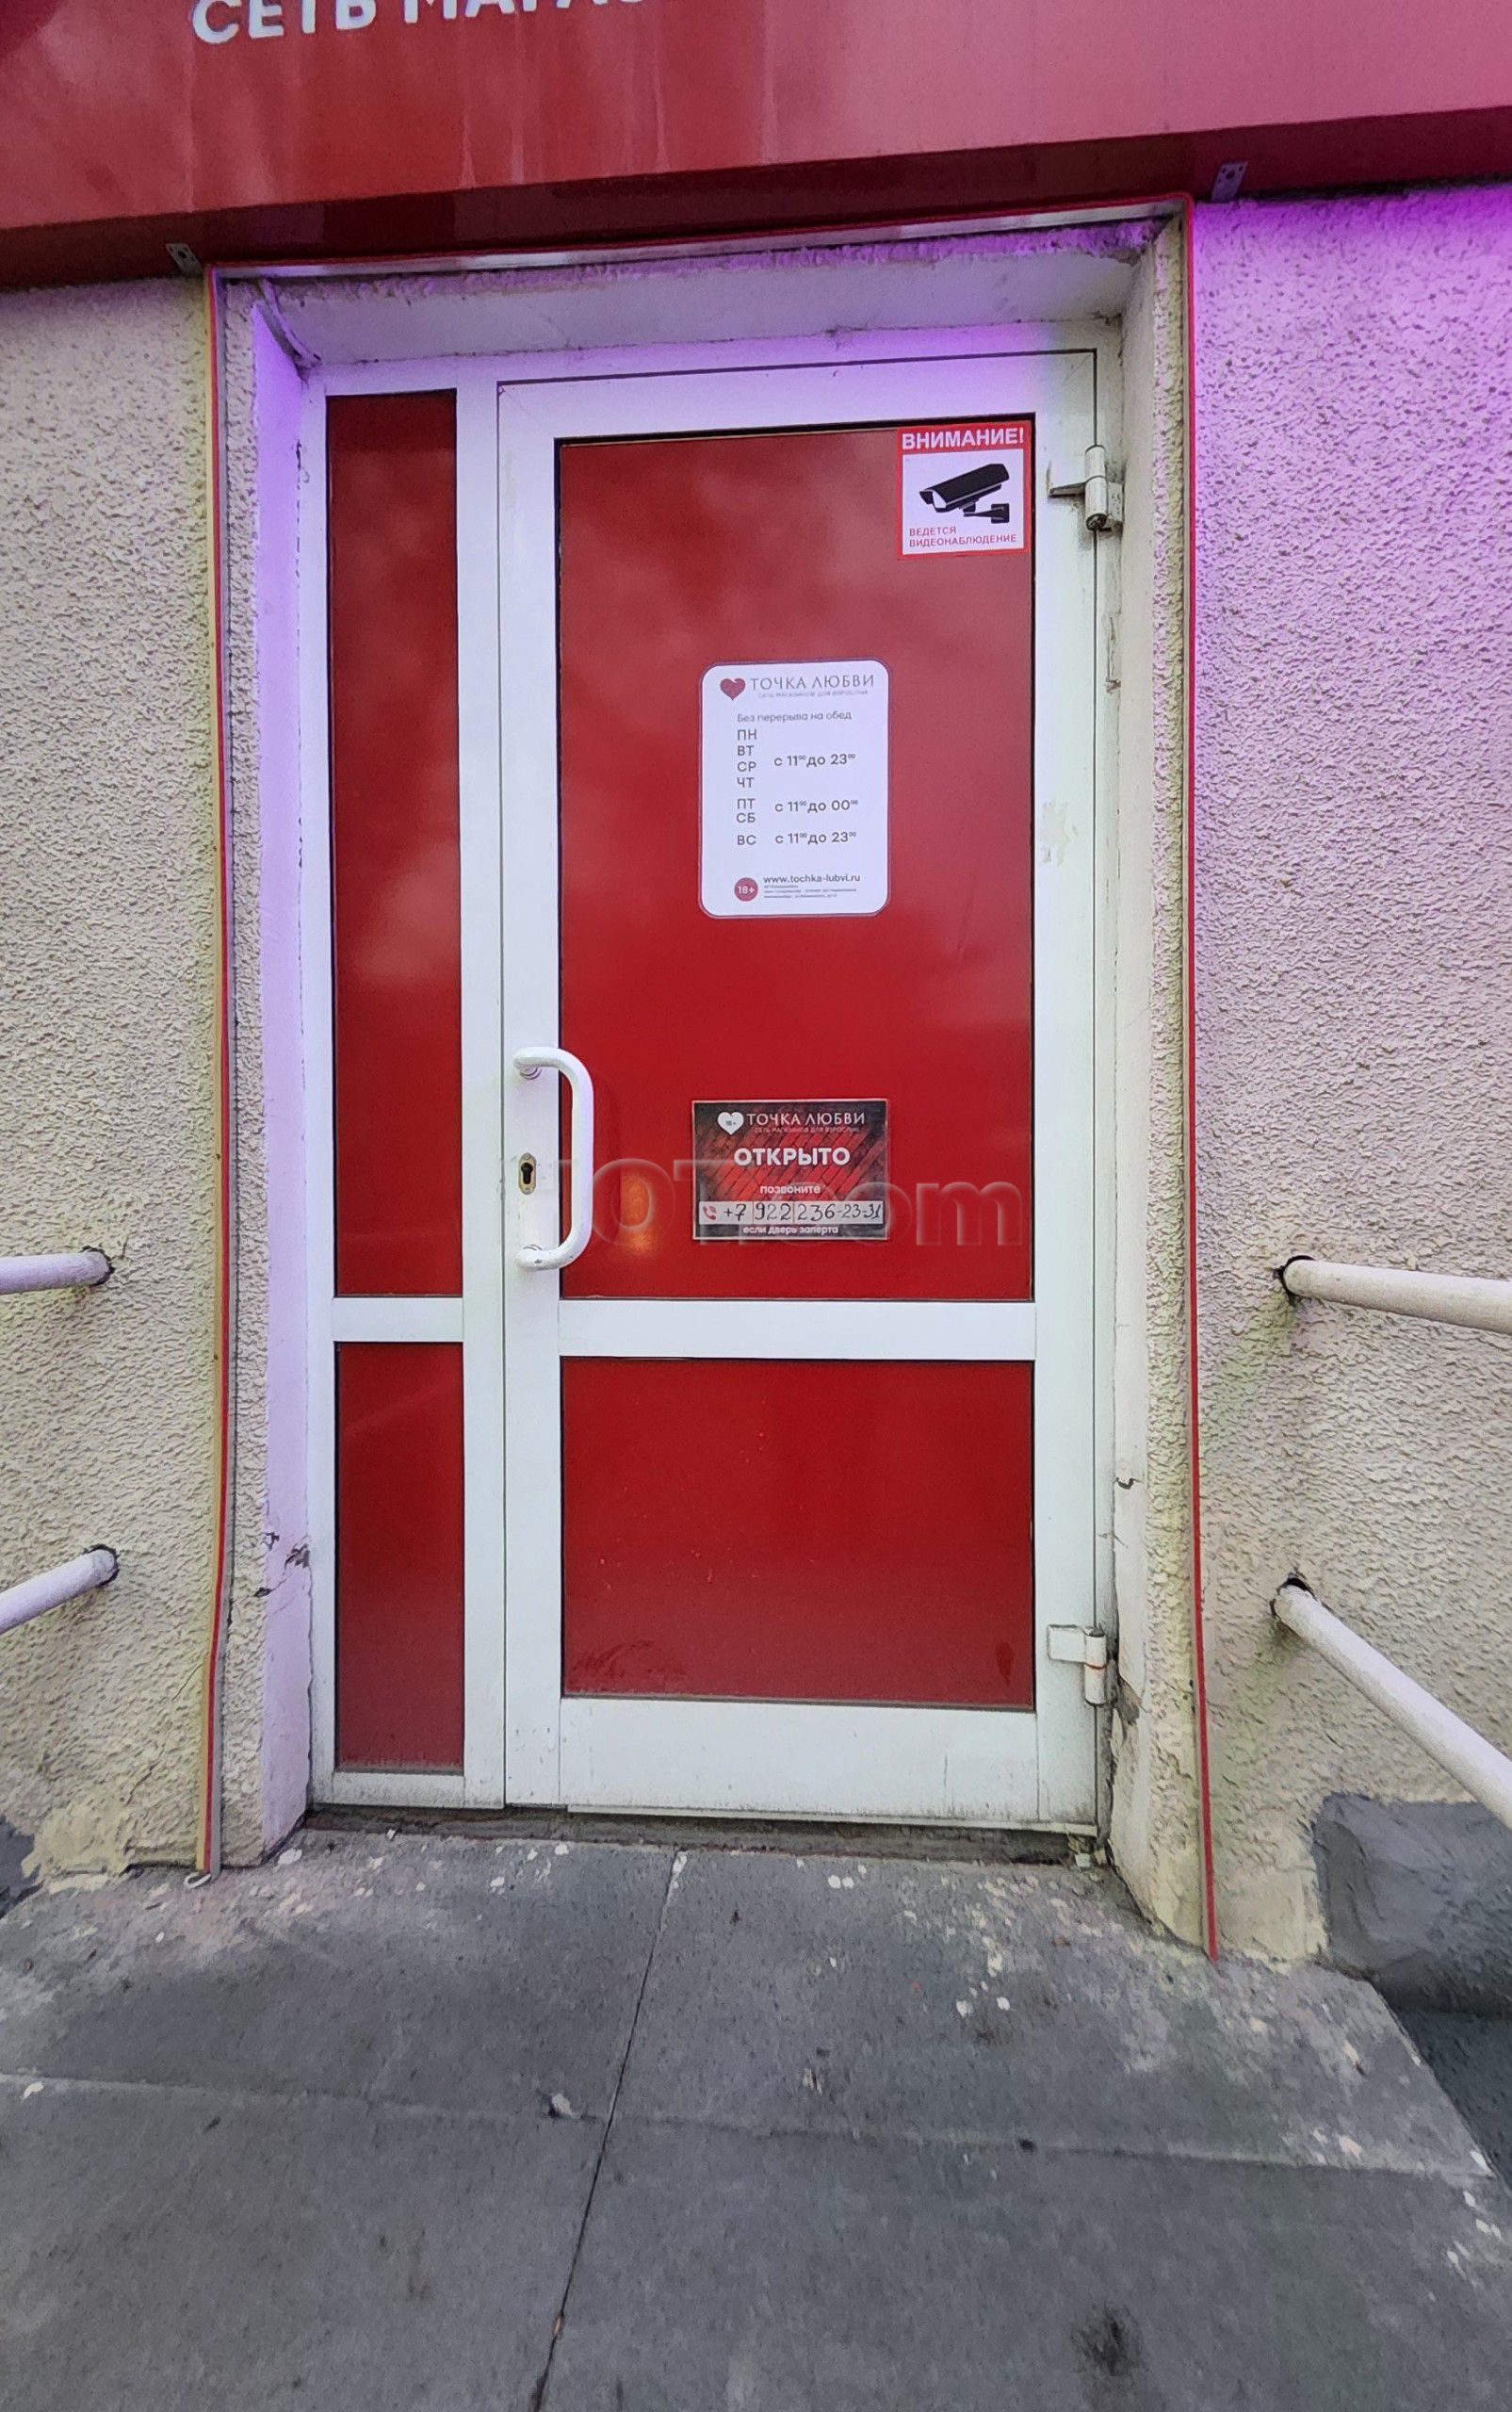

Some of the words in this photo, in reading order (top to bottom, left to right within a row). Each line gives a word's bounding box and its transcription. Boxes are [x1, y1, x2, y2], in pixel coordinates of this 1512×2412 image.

[902, 427, 1024, 449] ВНИМАНИЕ!
[909, 526, 957, 537] ВЕДЕТСЯ
[909, 534, 1016, 548] ВИДЕОНАБЛЮДЕНИЕ
[750, 676, 806, 691] ТОЧКА
[811, 675, 874, 689] ЛЮБВИ
[737, 713, 756, 723] Без
[756, 712, 808, 724] перерыва
[825, 710, 853, 721] обед
[737, 728, 757, 741] ПН
[737, 745, 755, 757] ВТ
[737, 761, 756, 773] СР
[773, 758, 784, 767] с
[806, 756, 826, 768] до
[737, 777, 755, 788] ЧТ
[737, 798, 756, 809] ПТ
[774, 803, 784, 812] с
[807, 802, 827, 813] до
[736, 812, 756, 823] СБ
[737, 835, 756, 846] ВС
[774, 835, 784, 844] с
[807, 834, 827, 845] до
[763, 873, 860, 884] www.tochka-lubvi.ru
[738, 886, 755, 895] 18+
[746, 1113, 801, 1126] ТОЧКА
[805, 1112, 865, 1125] ЛЮБВИ
[734, 1147, 851, 1166] ОТКРЫТО
[760, 1185, 821, 1194] позвоните
[768, 1226, 797, 1235] дверь
[799, 1226, 838, 1235] заперта
